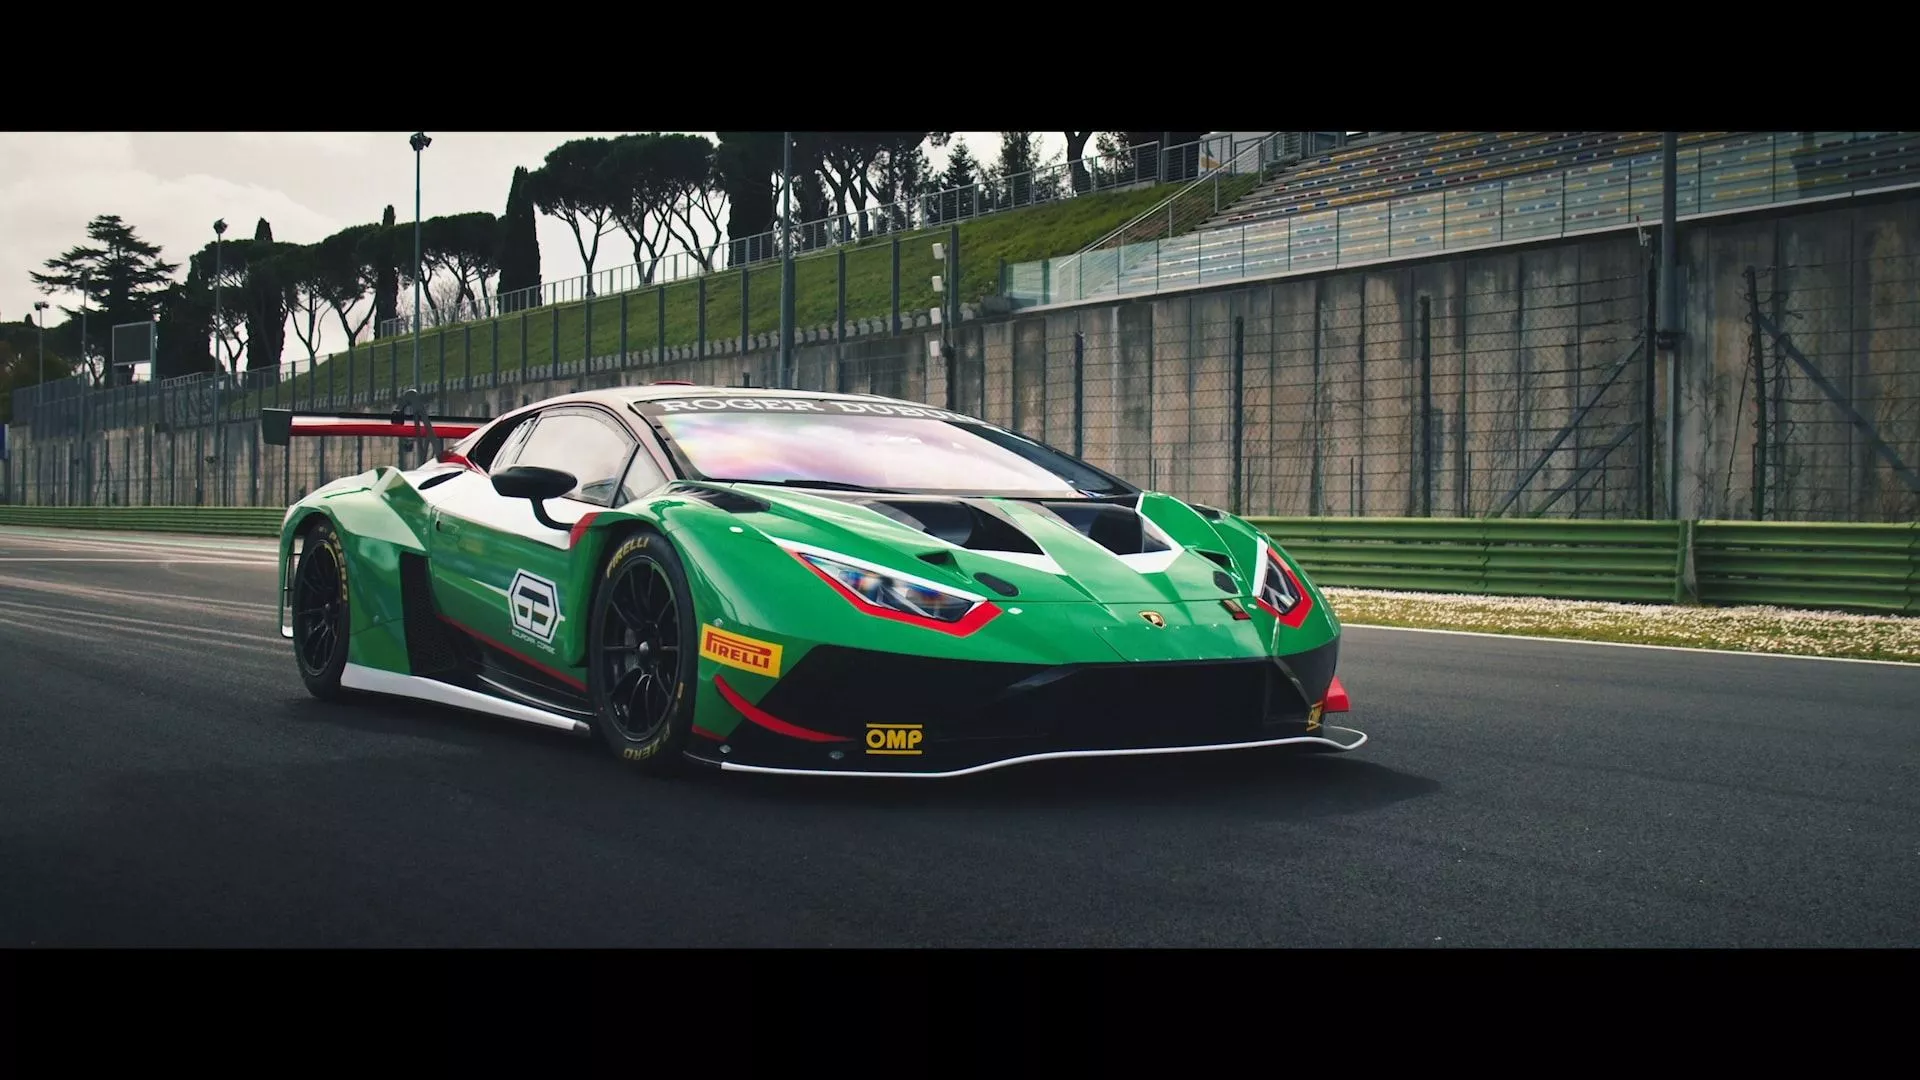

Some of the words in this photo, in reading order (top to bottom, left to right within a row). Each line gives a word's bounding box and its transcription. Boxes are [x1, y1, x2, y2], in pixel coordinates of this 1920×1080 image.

[655, 398, 825, 412] ROGER
[606, 536, 650, 578] PIRELLI
[705, 631, 772, 669] PIRELLI
[866, 728, 923, 749] OMP
